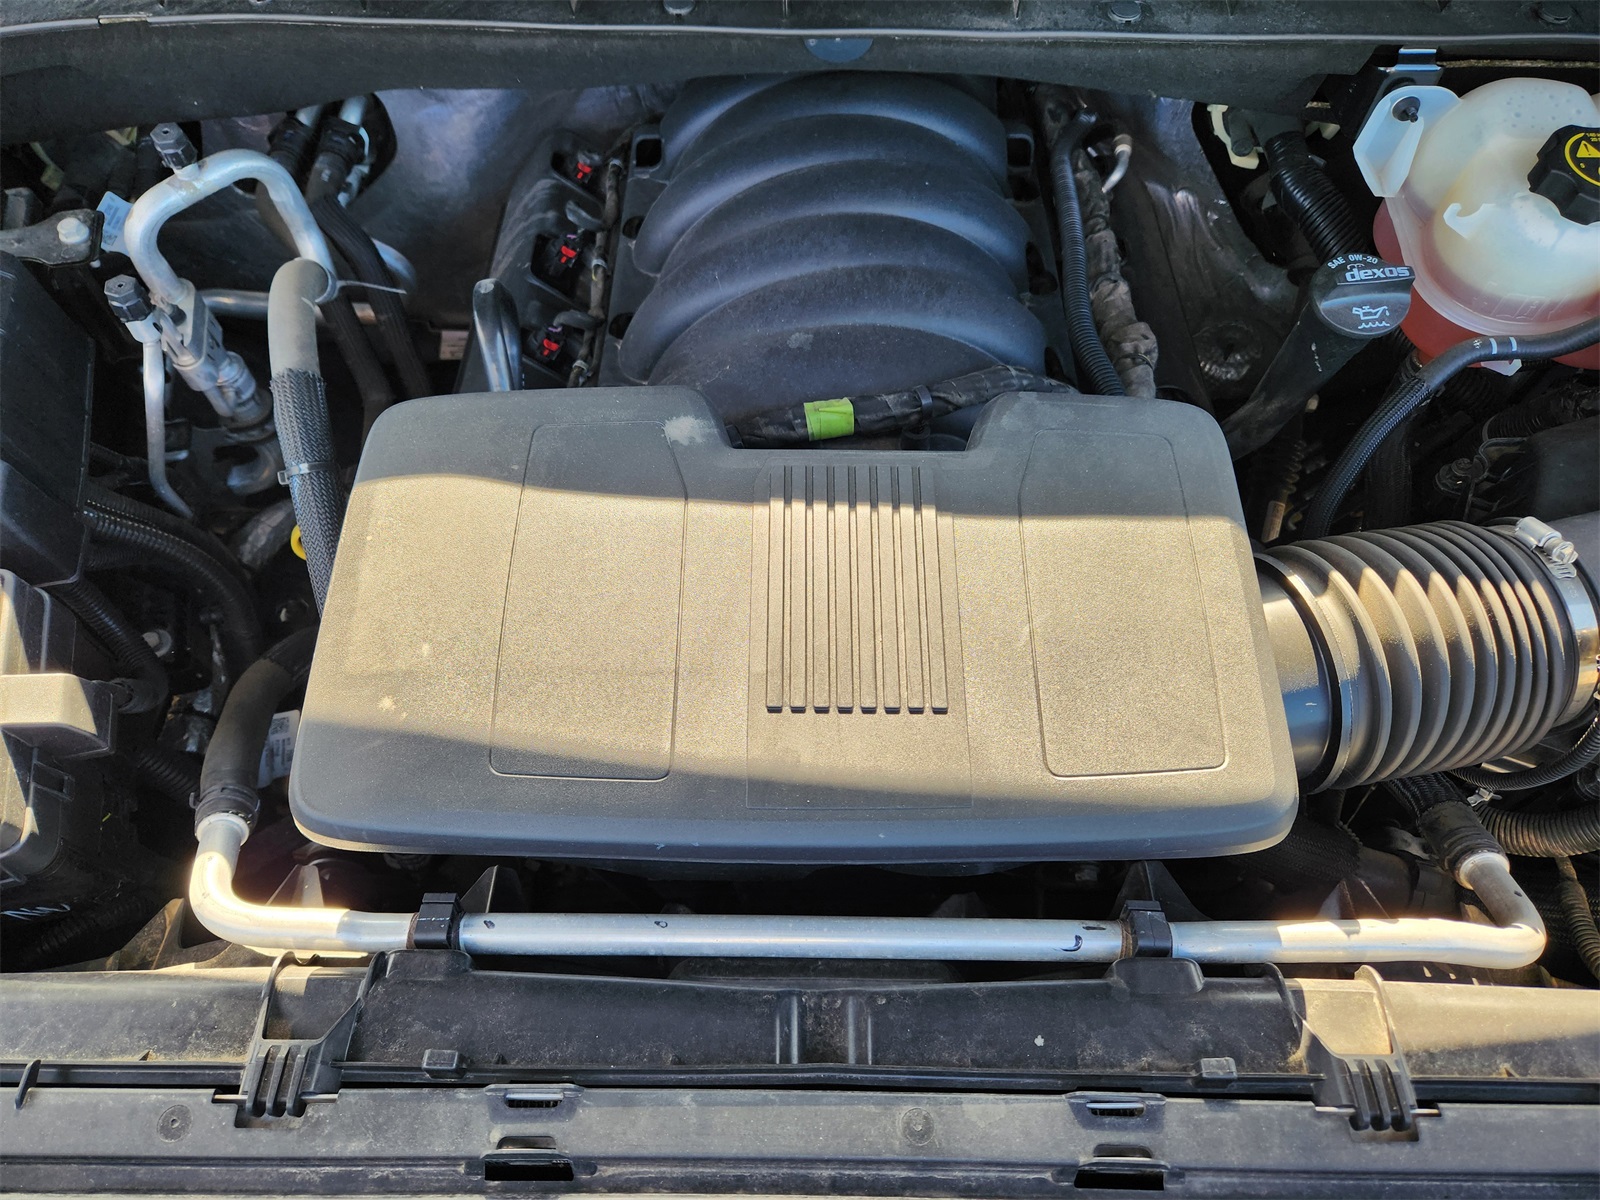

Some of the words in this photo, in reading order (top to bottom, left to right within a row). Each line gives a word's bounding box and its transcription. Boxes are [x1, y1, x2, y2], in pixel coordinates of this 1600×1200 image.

[1327, 256, 1346, 270] SAE
[1348, 254, 1378, 265] 0W-20
[1345, 266, 1410, 282] dexos
